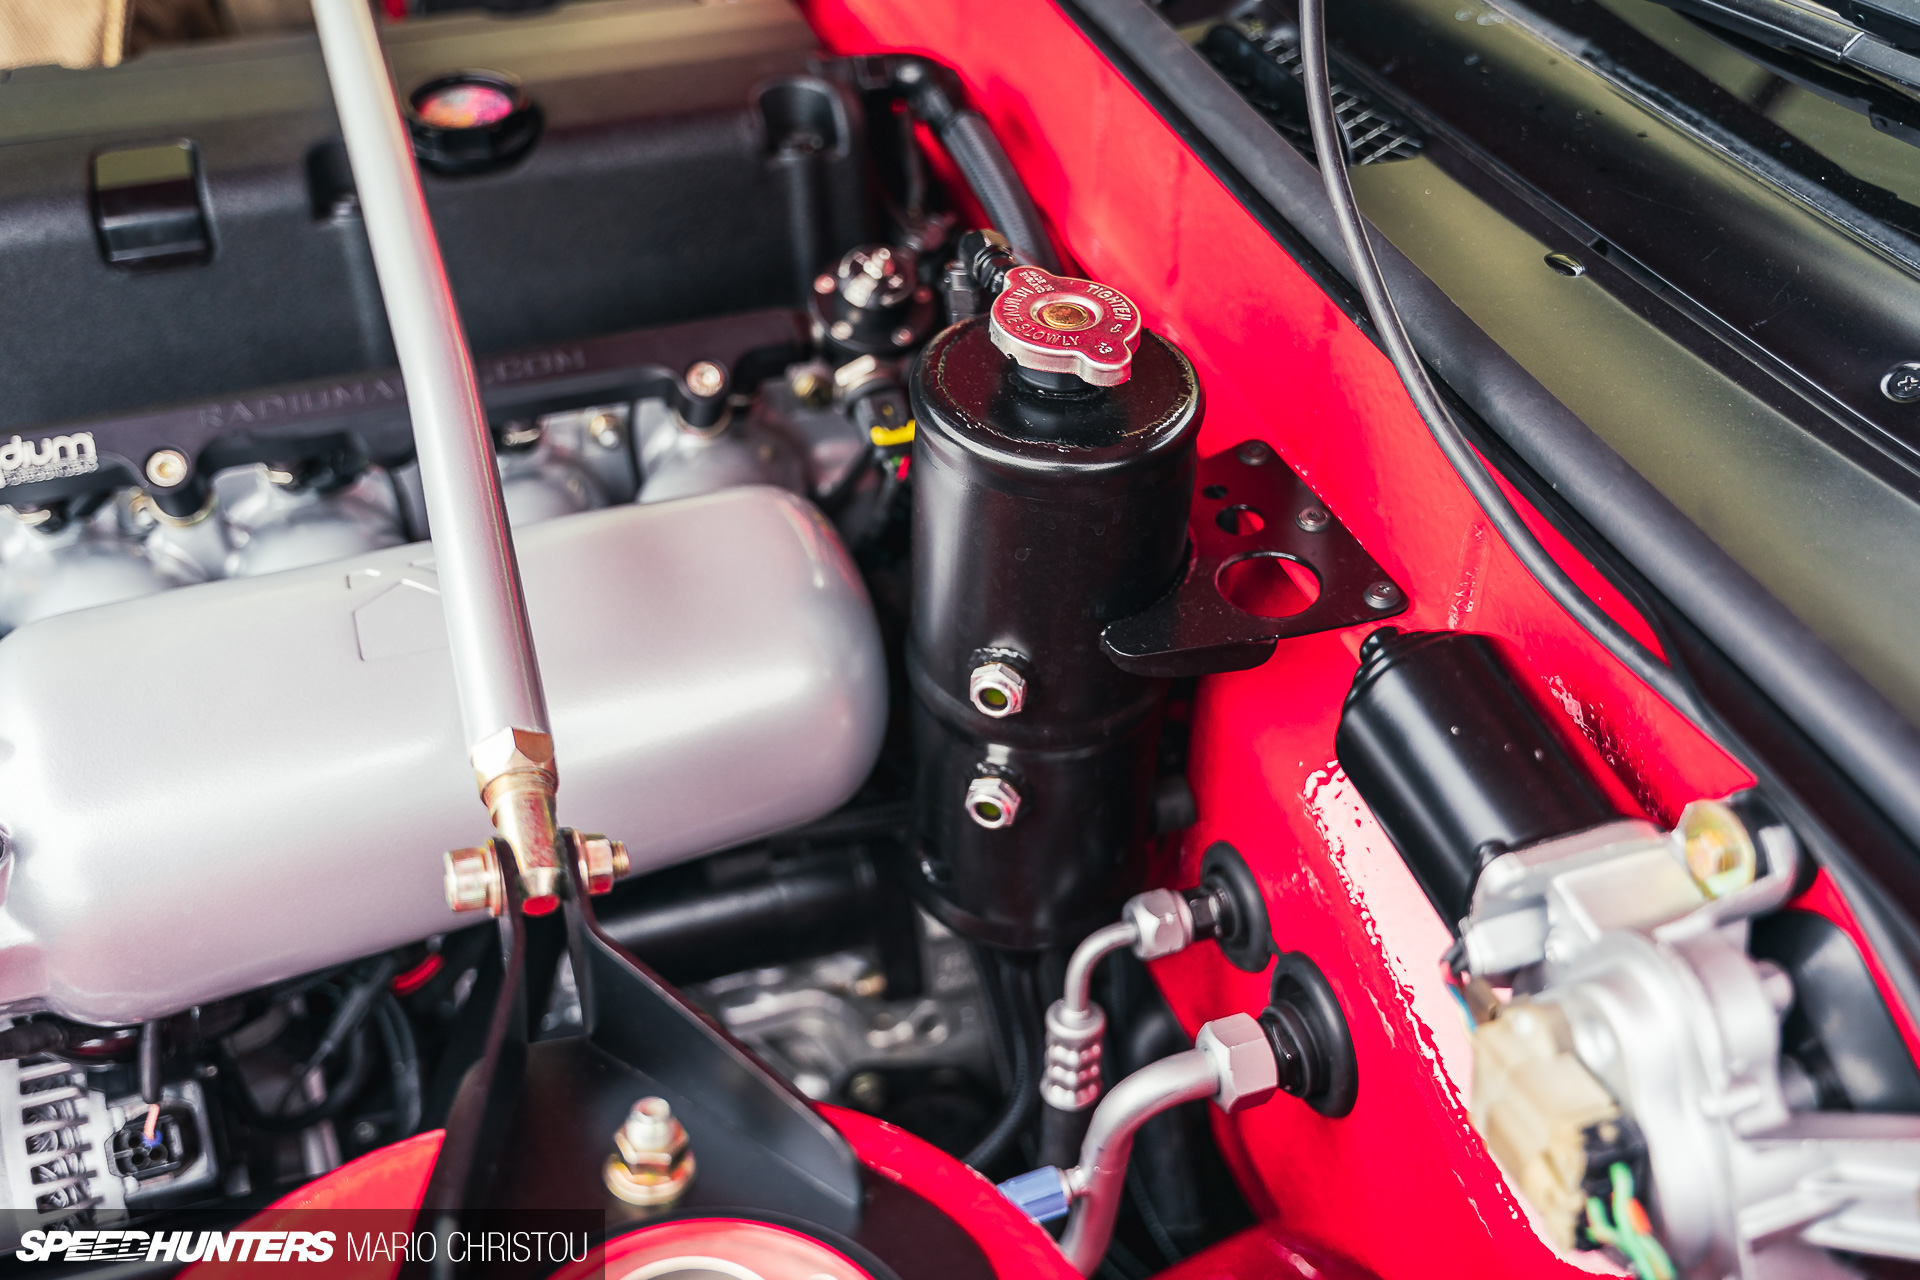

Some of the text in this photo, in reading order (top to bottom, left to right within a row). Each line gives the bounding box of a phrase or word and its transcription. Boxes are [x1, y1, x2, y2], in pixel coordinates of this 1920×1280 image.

[1086, 283, 1132, 321] TIGHTEN
[1015, 323, 1080, 346] SLOWLY
[0, 431, 97, 473] dium
